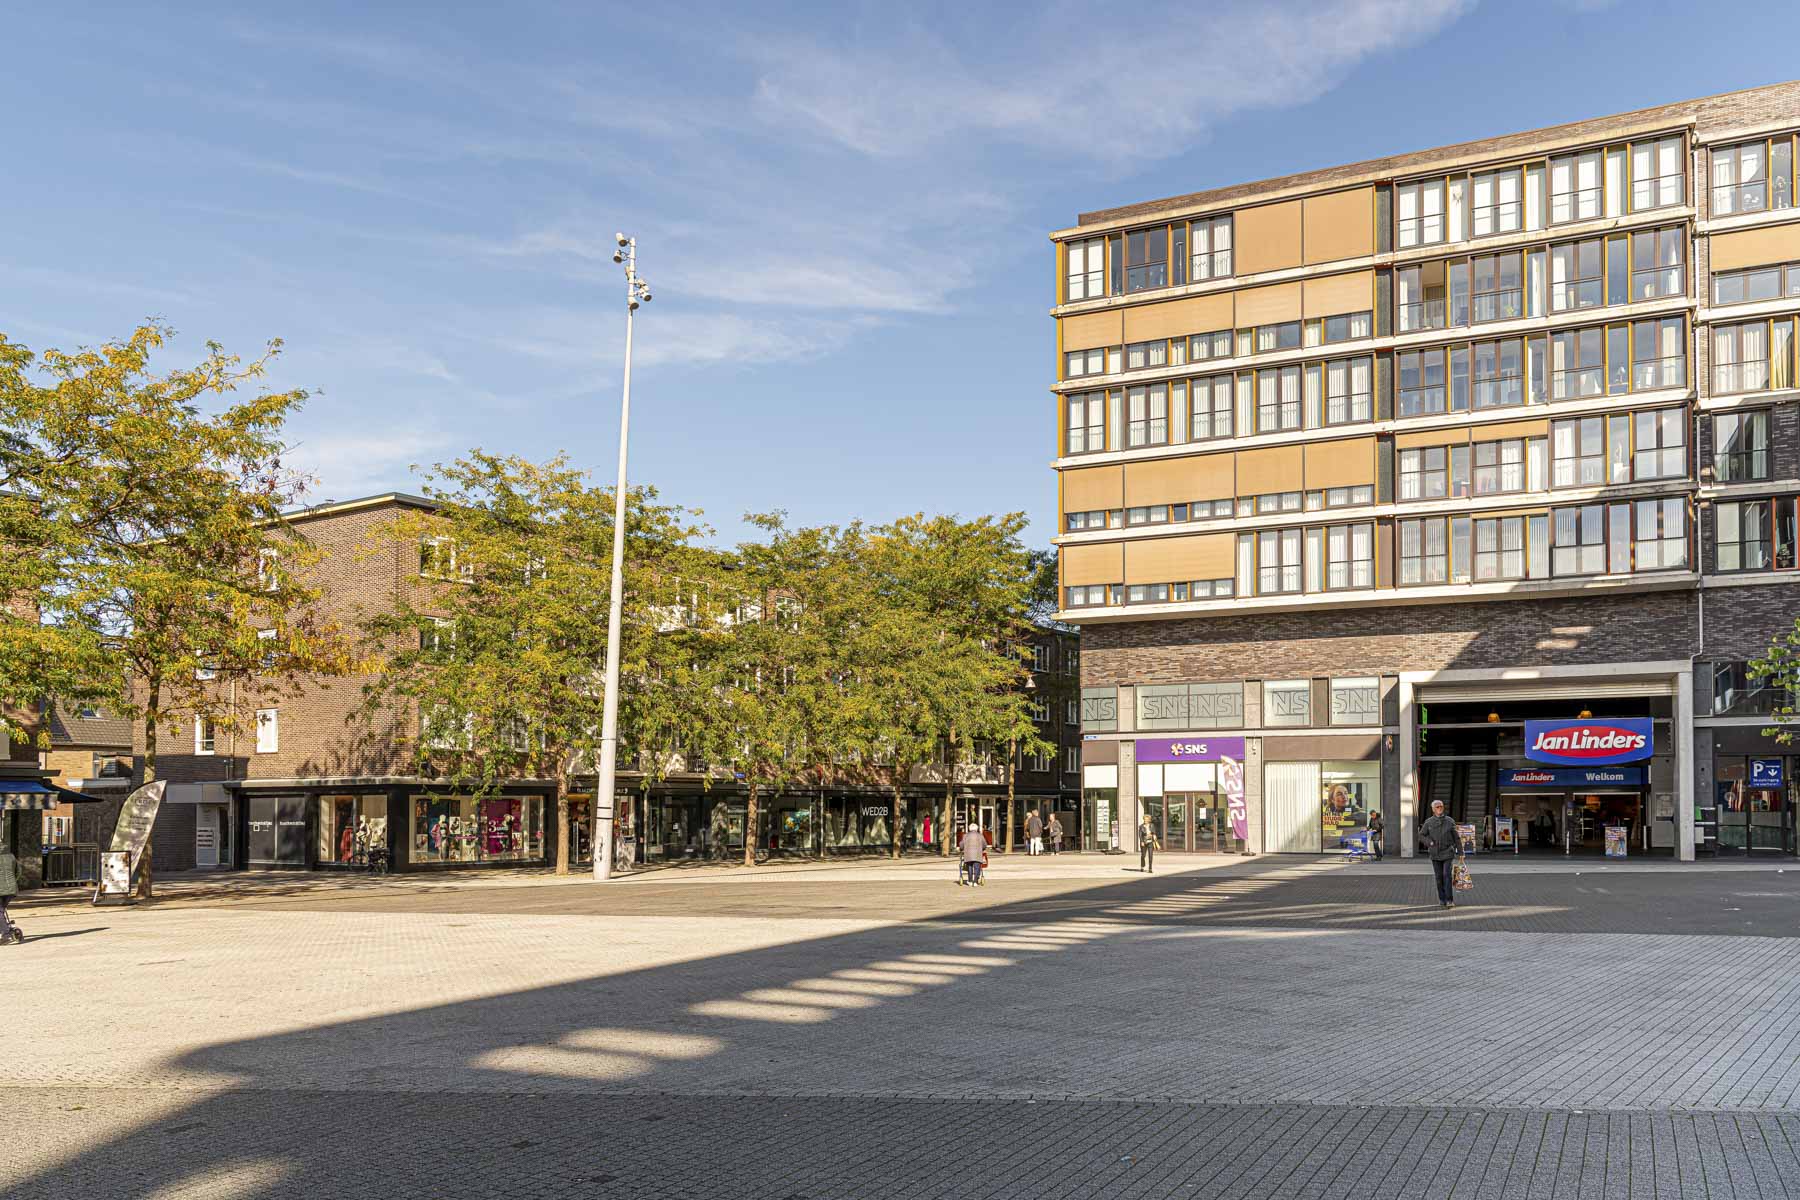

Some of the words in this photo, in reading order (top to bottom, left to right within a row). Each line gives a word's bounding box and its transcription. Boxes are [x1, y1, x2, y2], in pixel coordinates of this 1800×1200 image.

[1532, 732, 1568, 750] Jan
[1570, 729, 1647, 749] Linders
[1184, 744, 1208, 754] SNS
[1511, 774, 1526, 782] Jan
[1526, 773, 1555, 781] Linders
[1585, 772, 1624, 781] Welkom
[862, 806, 889, 817] WED2B
